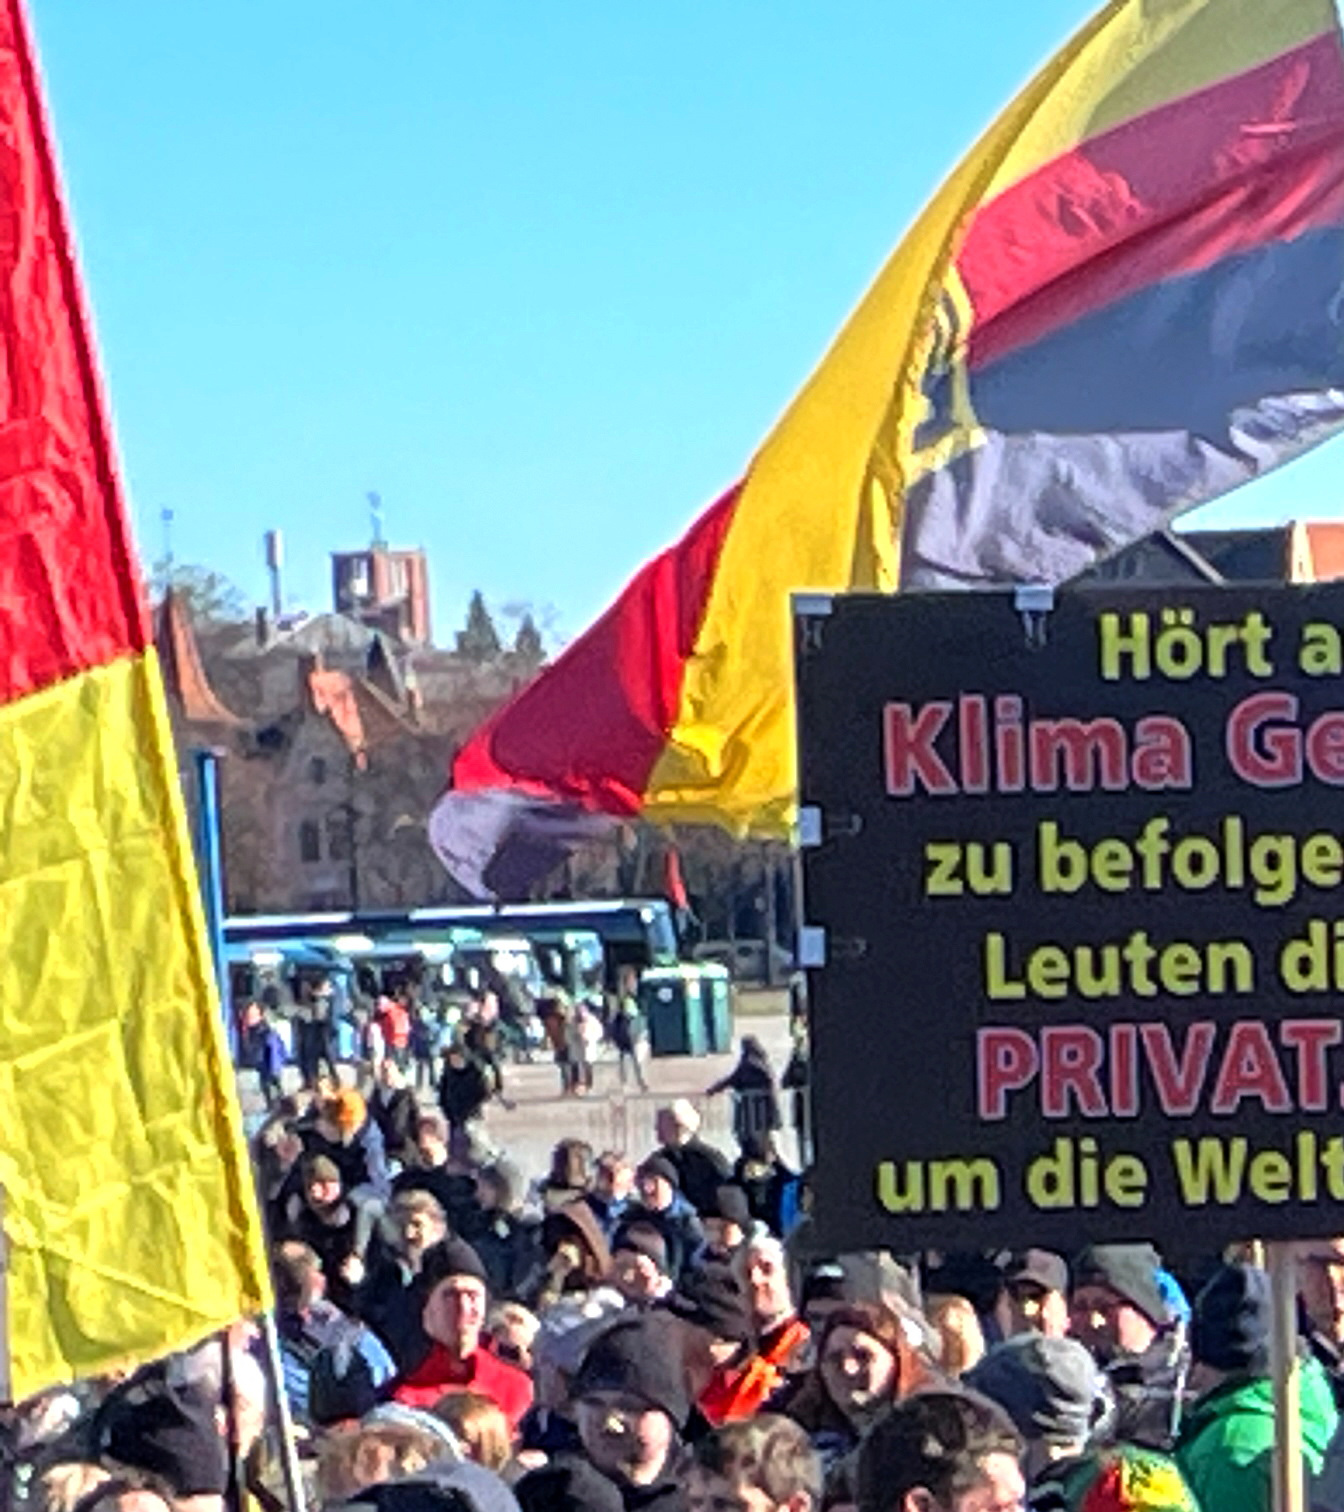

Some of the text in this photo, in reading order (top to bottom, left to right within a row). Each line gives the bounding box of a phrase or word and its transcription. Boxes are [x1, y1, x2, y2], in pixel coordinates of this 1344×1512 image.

[1098, 609, 1270, 679] Hört
[882, 693, 1194, 796] Klima
[924, 840, 1012, 895] zu
[984, 932, 1254, 1000] Leuten
[876, 1158, 999, 1213] um
[1026, 1138, 1147, 1208] die
